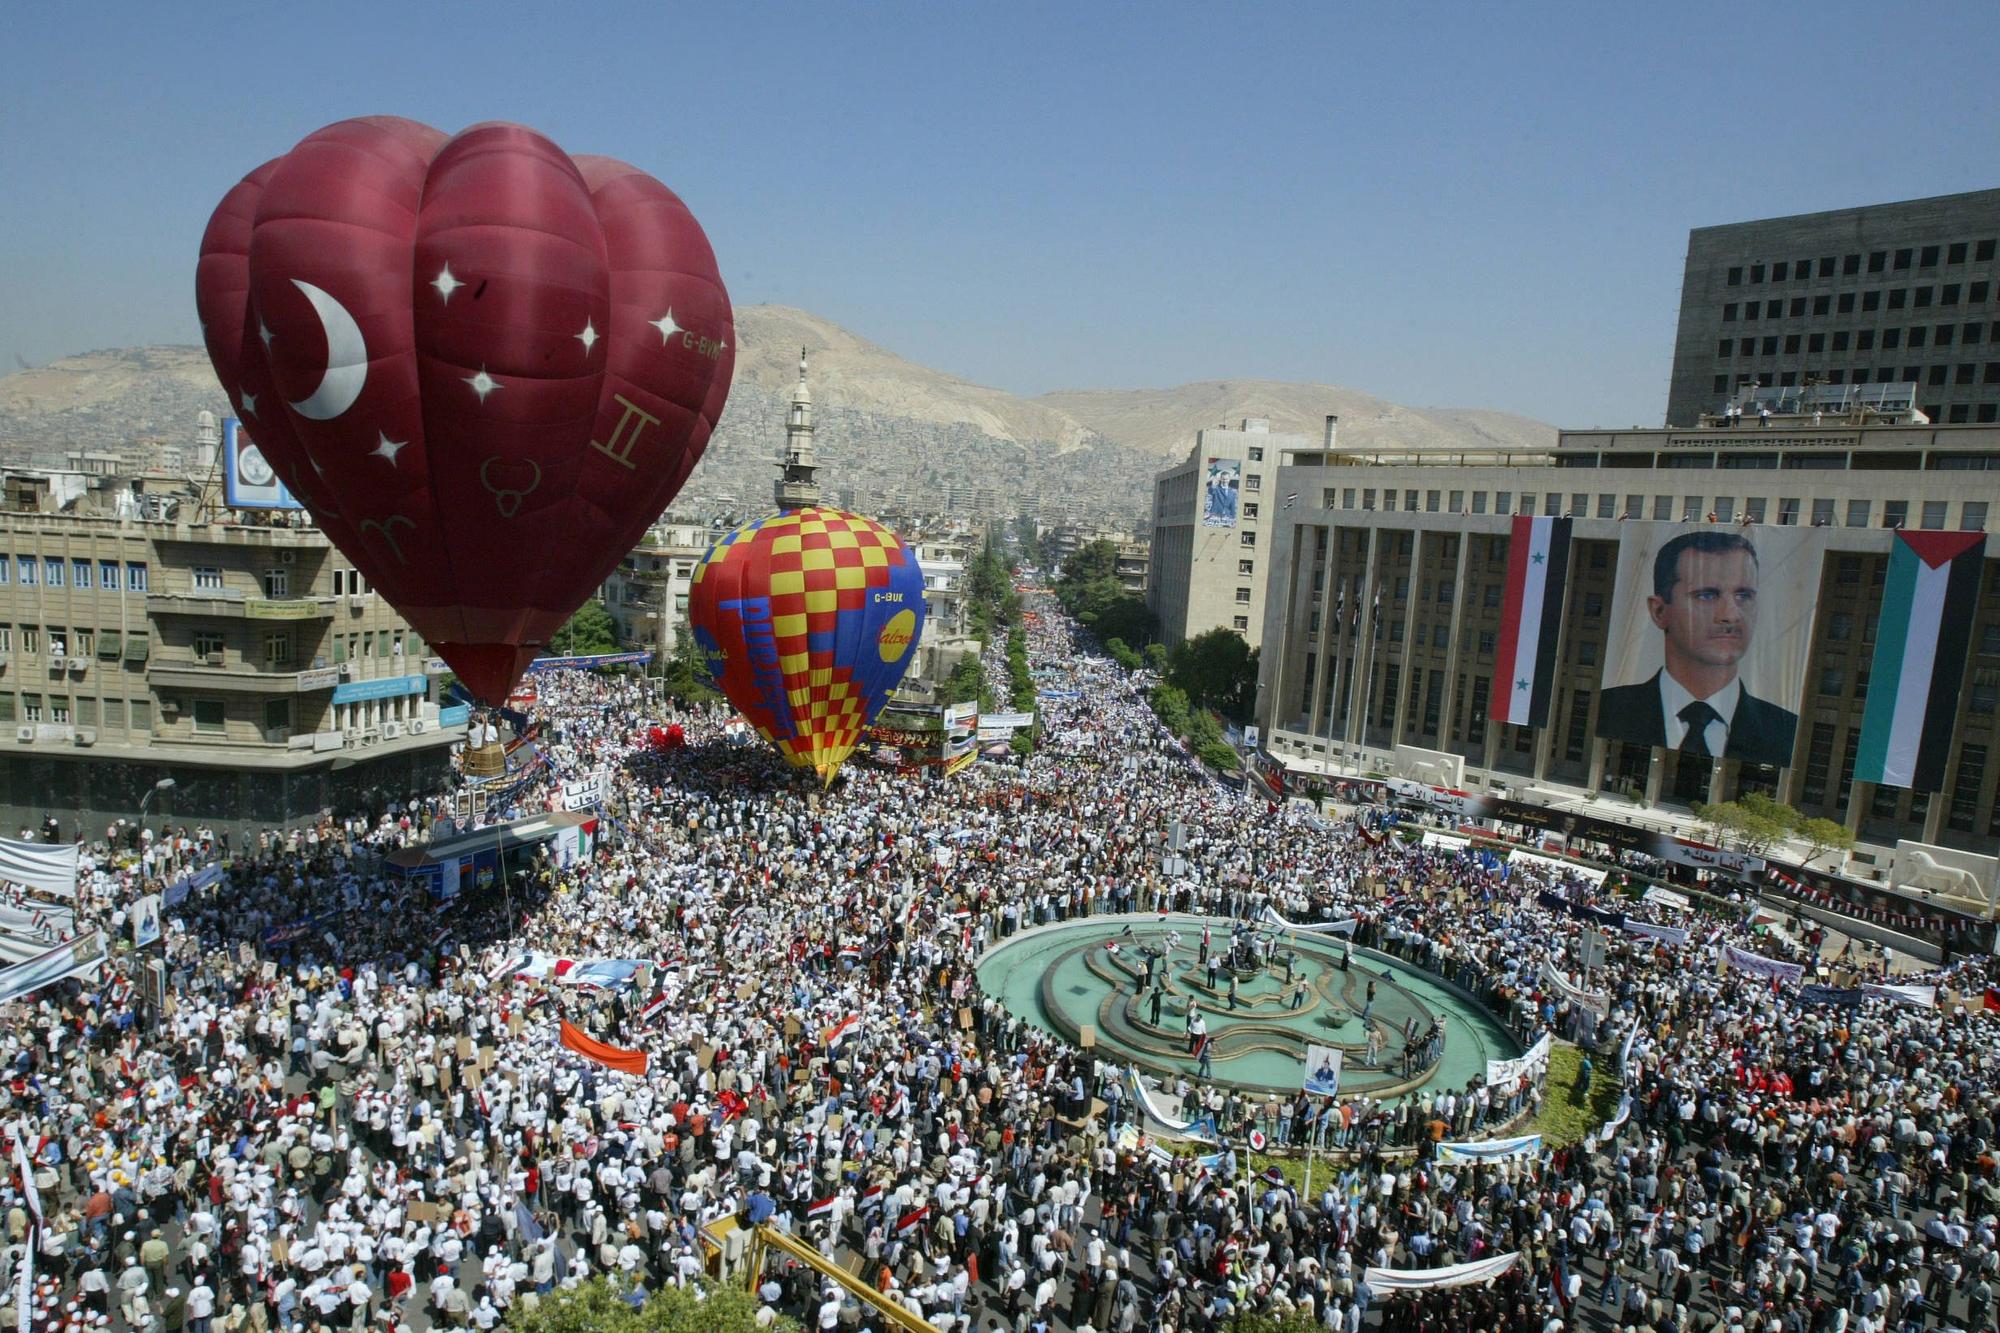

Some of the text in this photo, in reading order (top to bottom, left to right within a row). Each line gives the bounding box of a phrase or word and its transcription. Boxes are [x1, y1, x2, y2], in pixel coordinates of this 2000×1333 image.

[565, 779, 599, 797] كلنا
[569, 793, 600, 809] معك
[1691, 849, 1746, 872] كلنا معك
